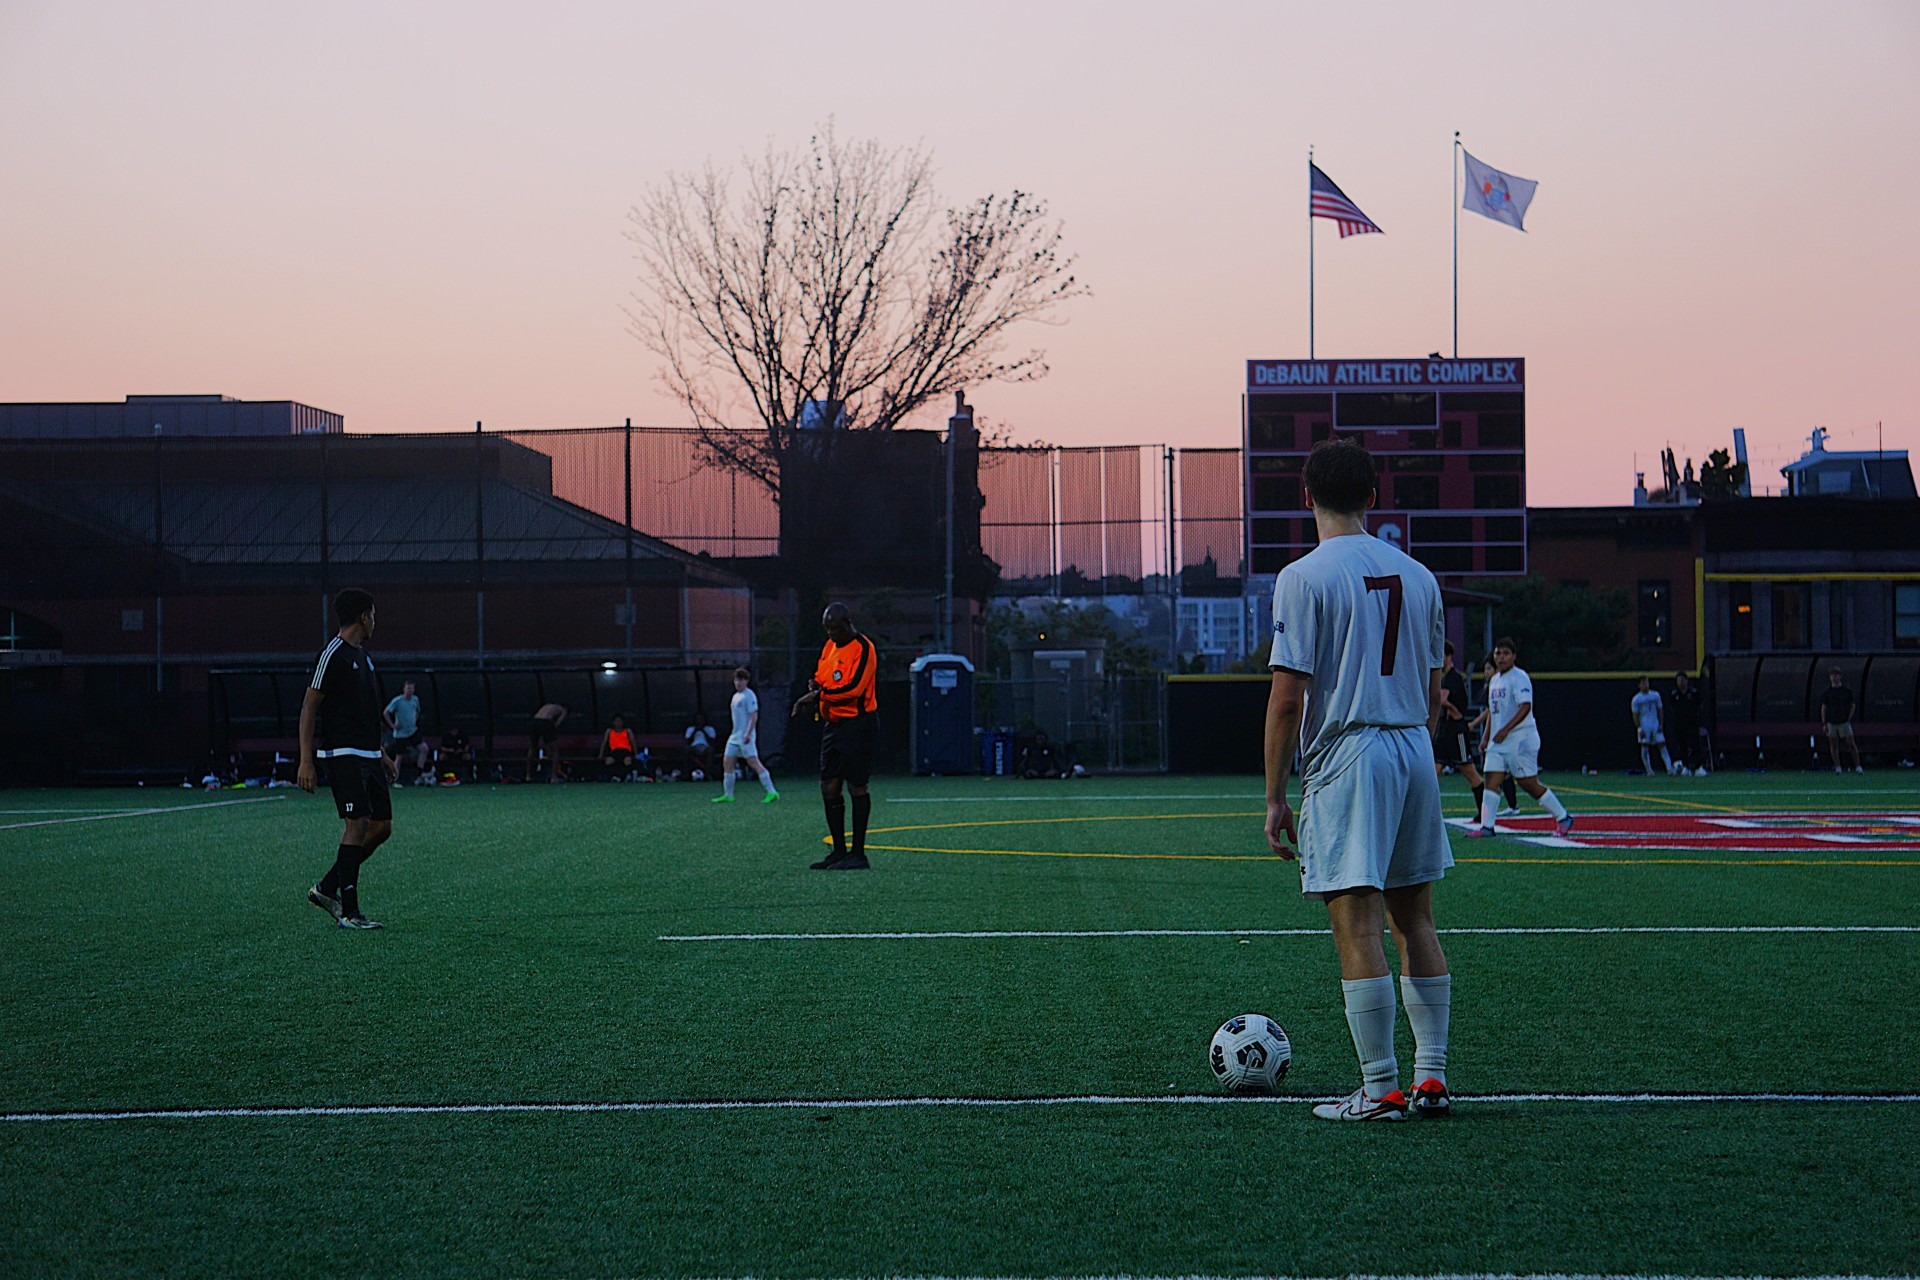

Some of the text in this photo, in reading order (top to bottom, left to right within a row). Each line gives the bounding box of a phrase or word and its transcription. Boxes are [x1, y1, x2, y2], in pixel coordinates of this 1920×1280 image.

[1334, 362, 1422, 384] ATHLETIC
[1427, 361, 1518, 383] COMPLEX
[1363, 574, 1403, 676] 7
[345, 802, 354, 812] 17
